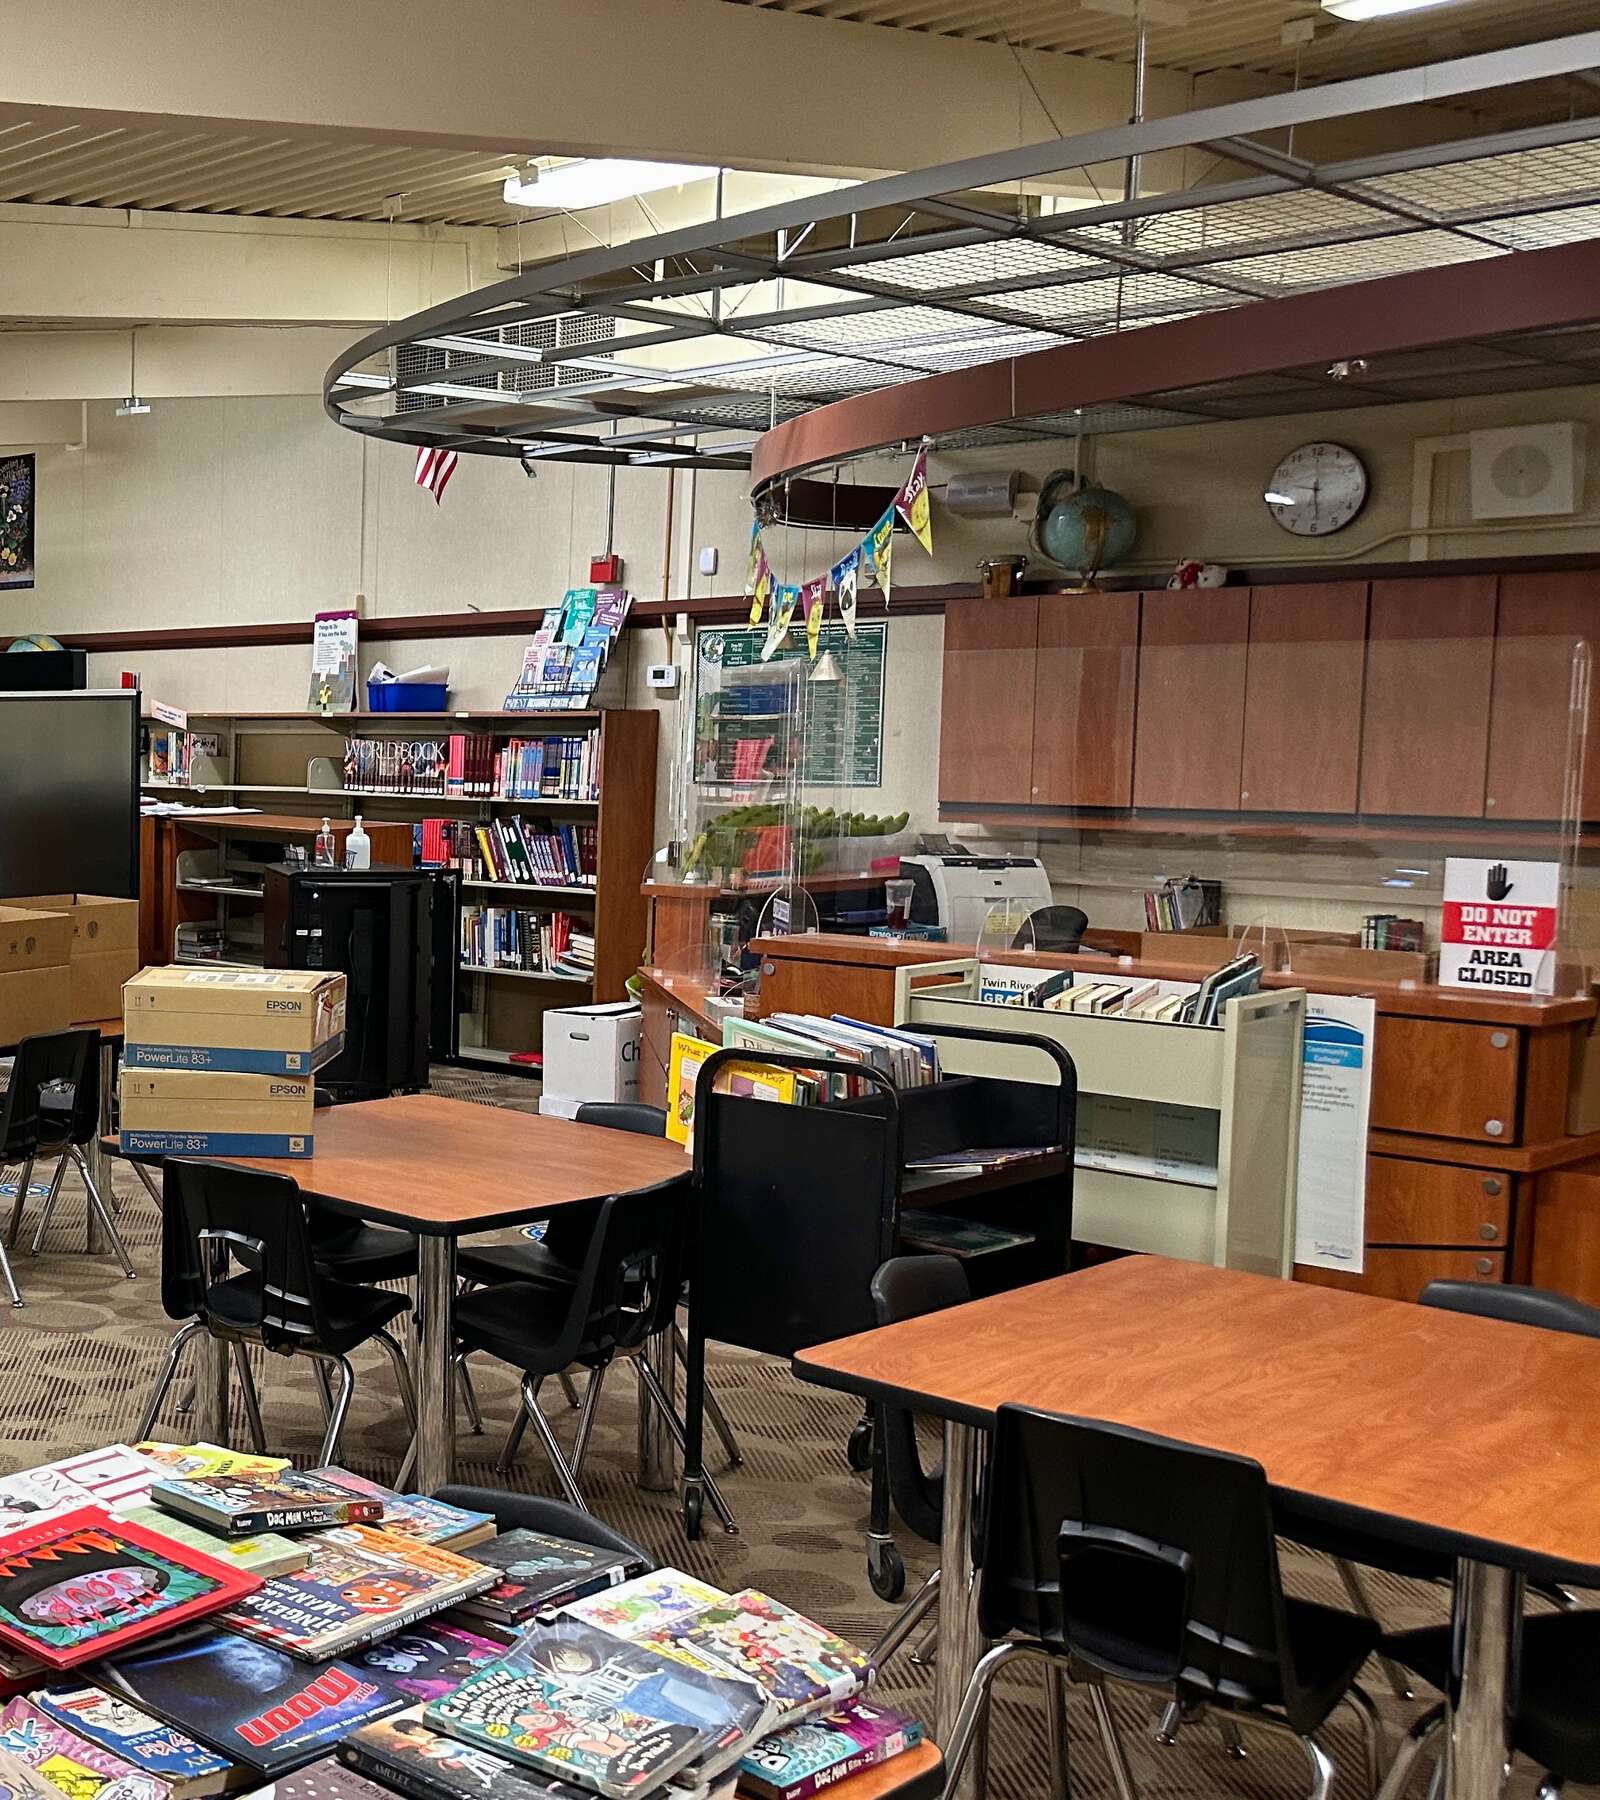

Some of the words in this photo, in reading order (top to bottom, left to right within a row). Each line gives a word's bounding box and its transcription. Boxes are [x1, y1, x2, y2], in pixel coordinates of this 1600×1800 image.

[344, 741, 398, 761] WORLD
[401, 741, 445, 761] BOOK
[1460, 905, 1488, 923] DO
[1492, 908, 1537, 926] NOT
[1462, 925, 1533, 945] ENTER
[1469, 949, 1523, 967] AREA
[982, 977, 1007, 988] Twin
[1458, 967, 1532, 987] CLOSED
[266, 1000, 302, 1011] EPSON
[136, 1051, 189, 1064] PowerLite
[191, 1053, 213, 1064] 83+
[622, 1042, 640, 1062] Ch
[678, 1043, 701, 1057] What
[1307, 1045, 1349, 1056] Community
[269, 1085, 306, 1095] EPSON
[129, 1137, 184, 1150] PowerLite
[186, 1139, 208, 1150] 83+
[266, 1512, 284, 1527] DOG
[49, 1571, 136, 1616] SOUP
[62, 1587, 163, 1632] MEAN
[286, 1591, 347, 1617] MAN
[350, 1681, 379, 1704] THE
[439, 1670, 513, 1718] CAPTAIN
[460, 1675, 543, 1725] UNDERPANTS
[234, 1666, 363, 1747] MOON
[373, 1764, 410, 1788] AMULET
[814, 1769, 832, 1789] DOG
